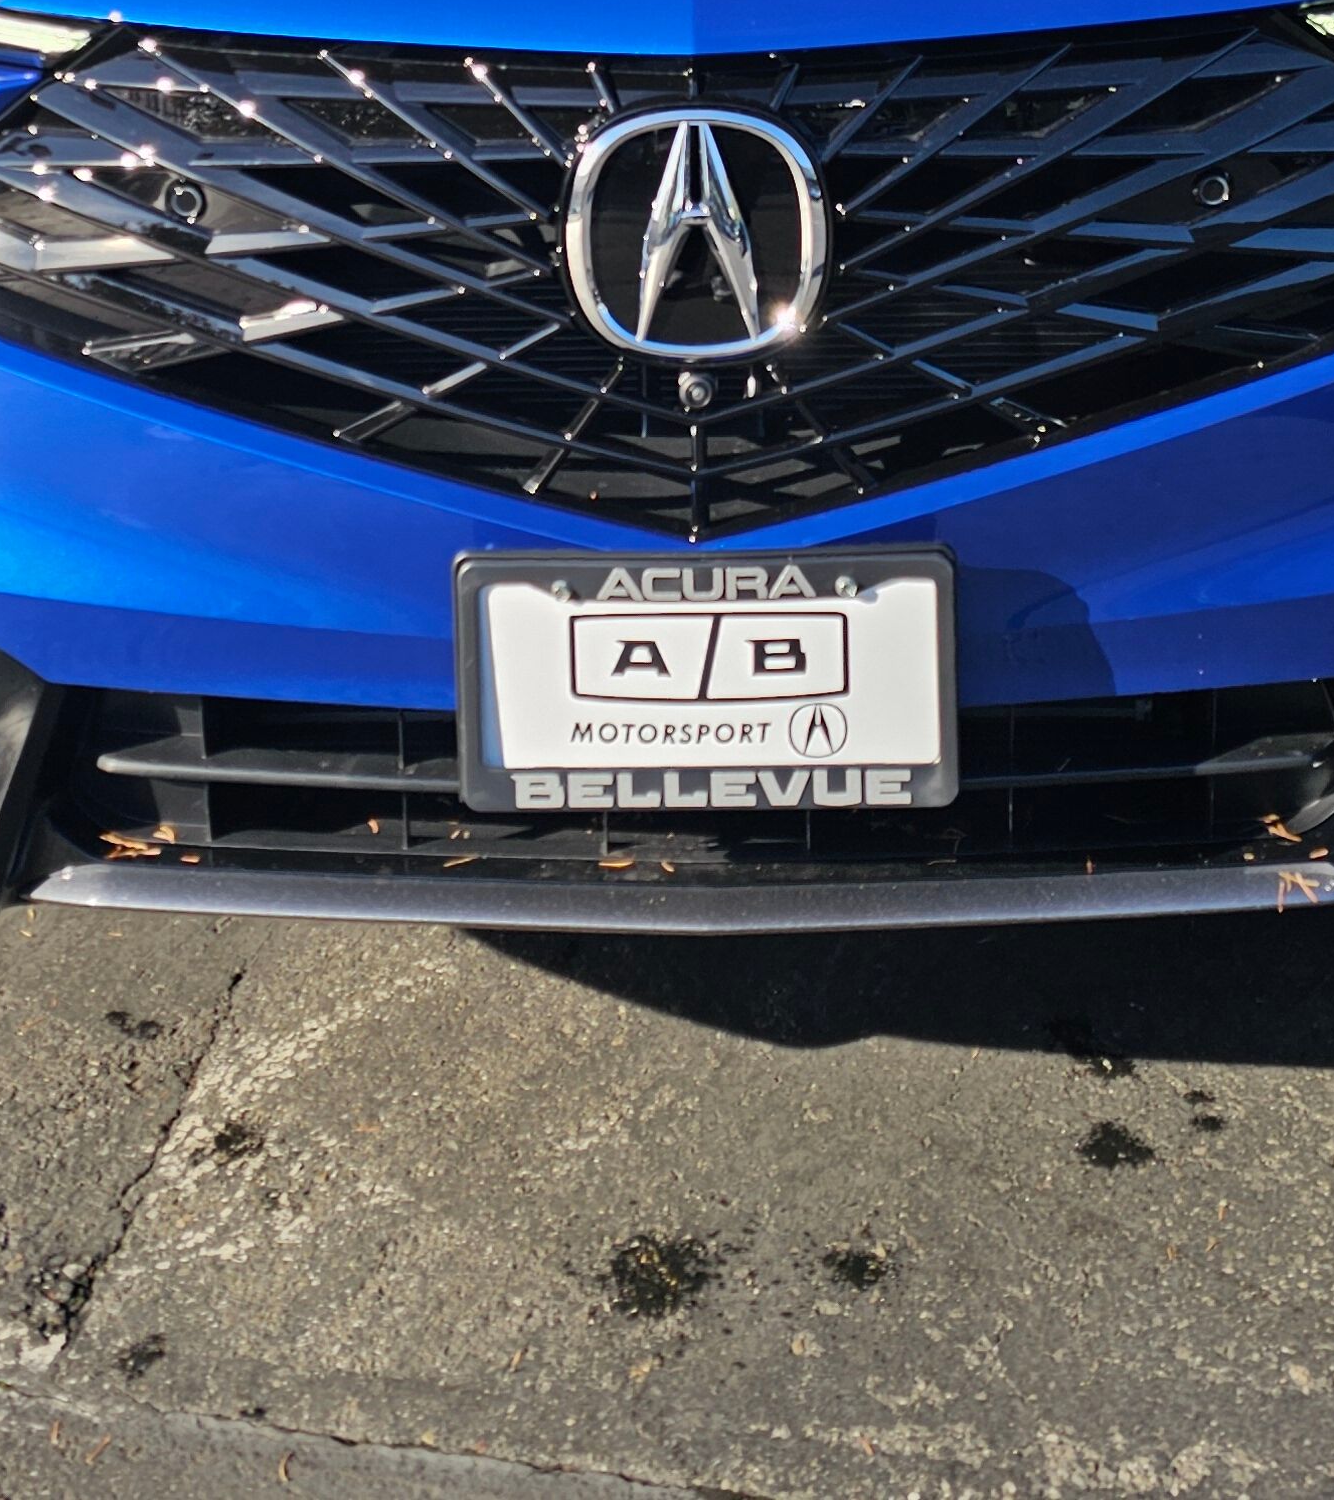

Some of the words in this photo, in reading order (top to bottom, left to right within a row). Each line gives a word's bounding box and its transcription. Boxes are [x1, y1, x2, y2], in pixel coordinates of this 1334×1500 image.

[596, 564, 817, 601] ACURA
[569, 721, 771, 746] MOTORSPORT
[510, 768, 913, 810] BELLEVUE
